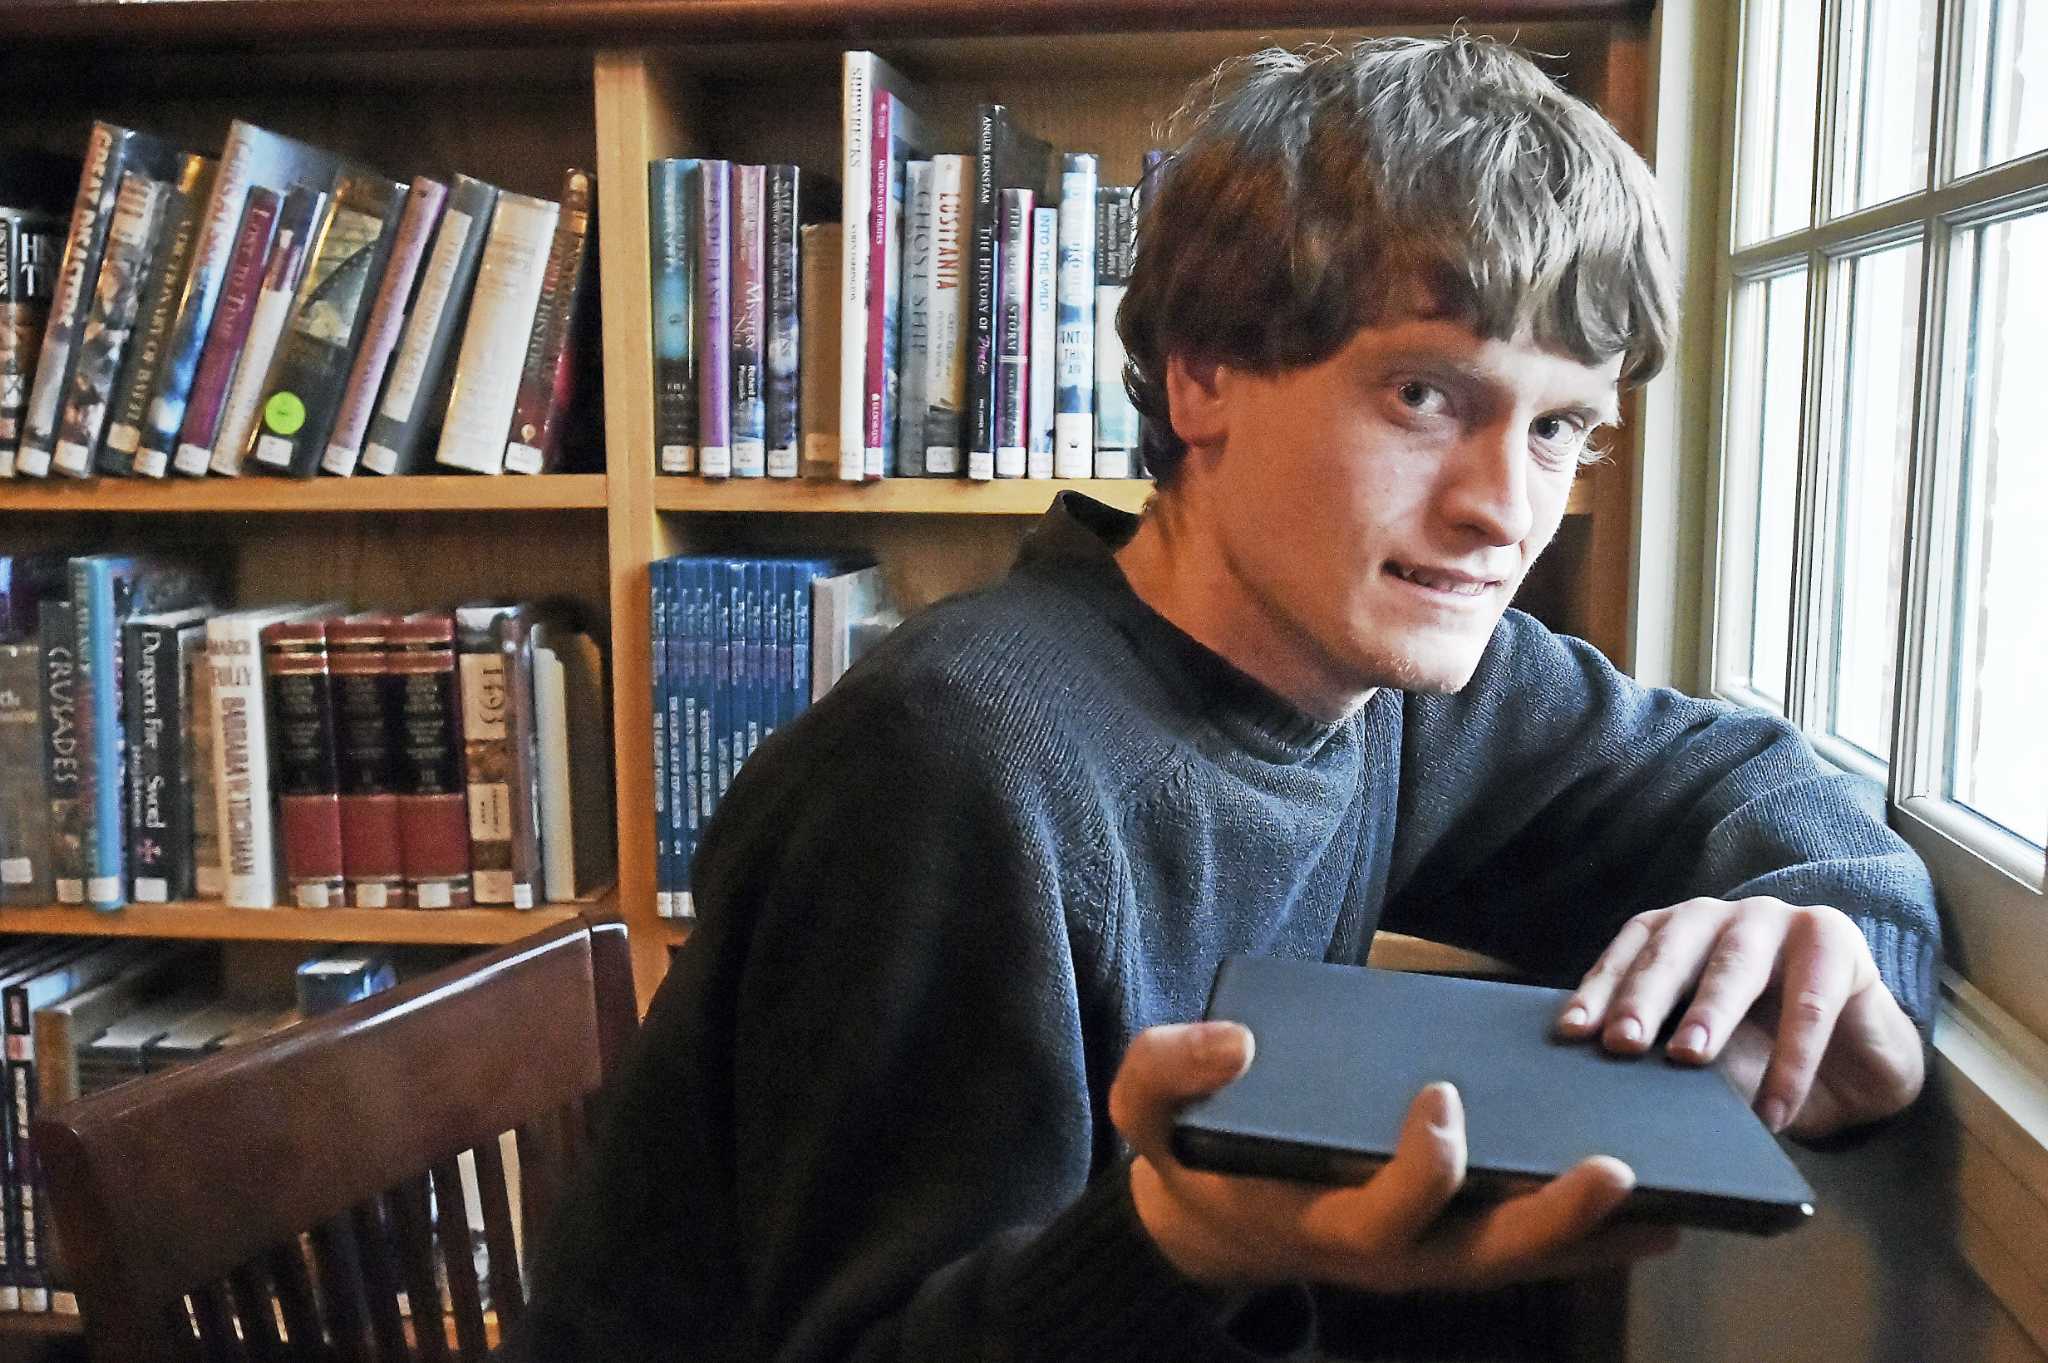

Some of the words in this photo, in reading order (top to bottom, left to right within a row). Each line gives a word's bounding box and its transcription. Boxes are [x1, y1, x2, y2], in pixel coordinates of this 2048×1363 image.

[982, 115, 992, 152] ANGUS
[980, 154, 991, 203] KONSTAM
[911, 191, 931, 282] GHOST
[935, 191, 961, 290] LUSITANIA
[978, 226, 991, 250] THE
[977, 257, 991, 313] HISTORY
[911, 294, 929, 354] SHIP
[978, 316, 988, 329] OF
[1007, 304, 1018, 349] STORM
[47, 646, 77, 782] CRUSADES
